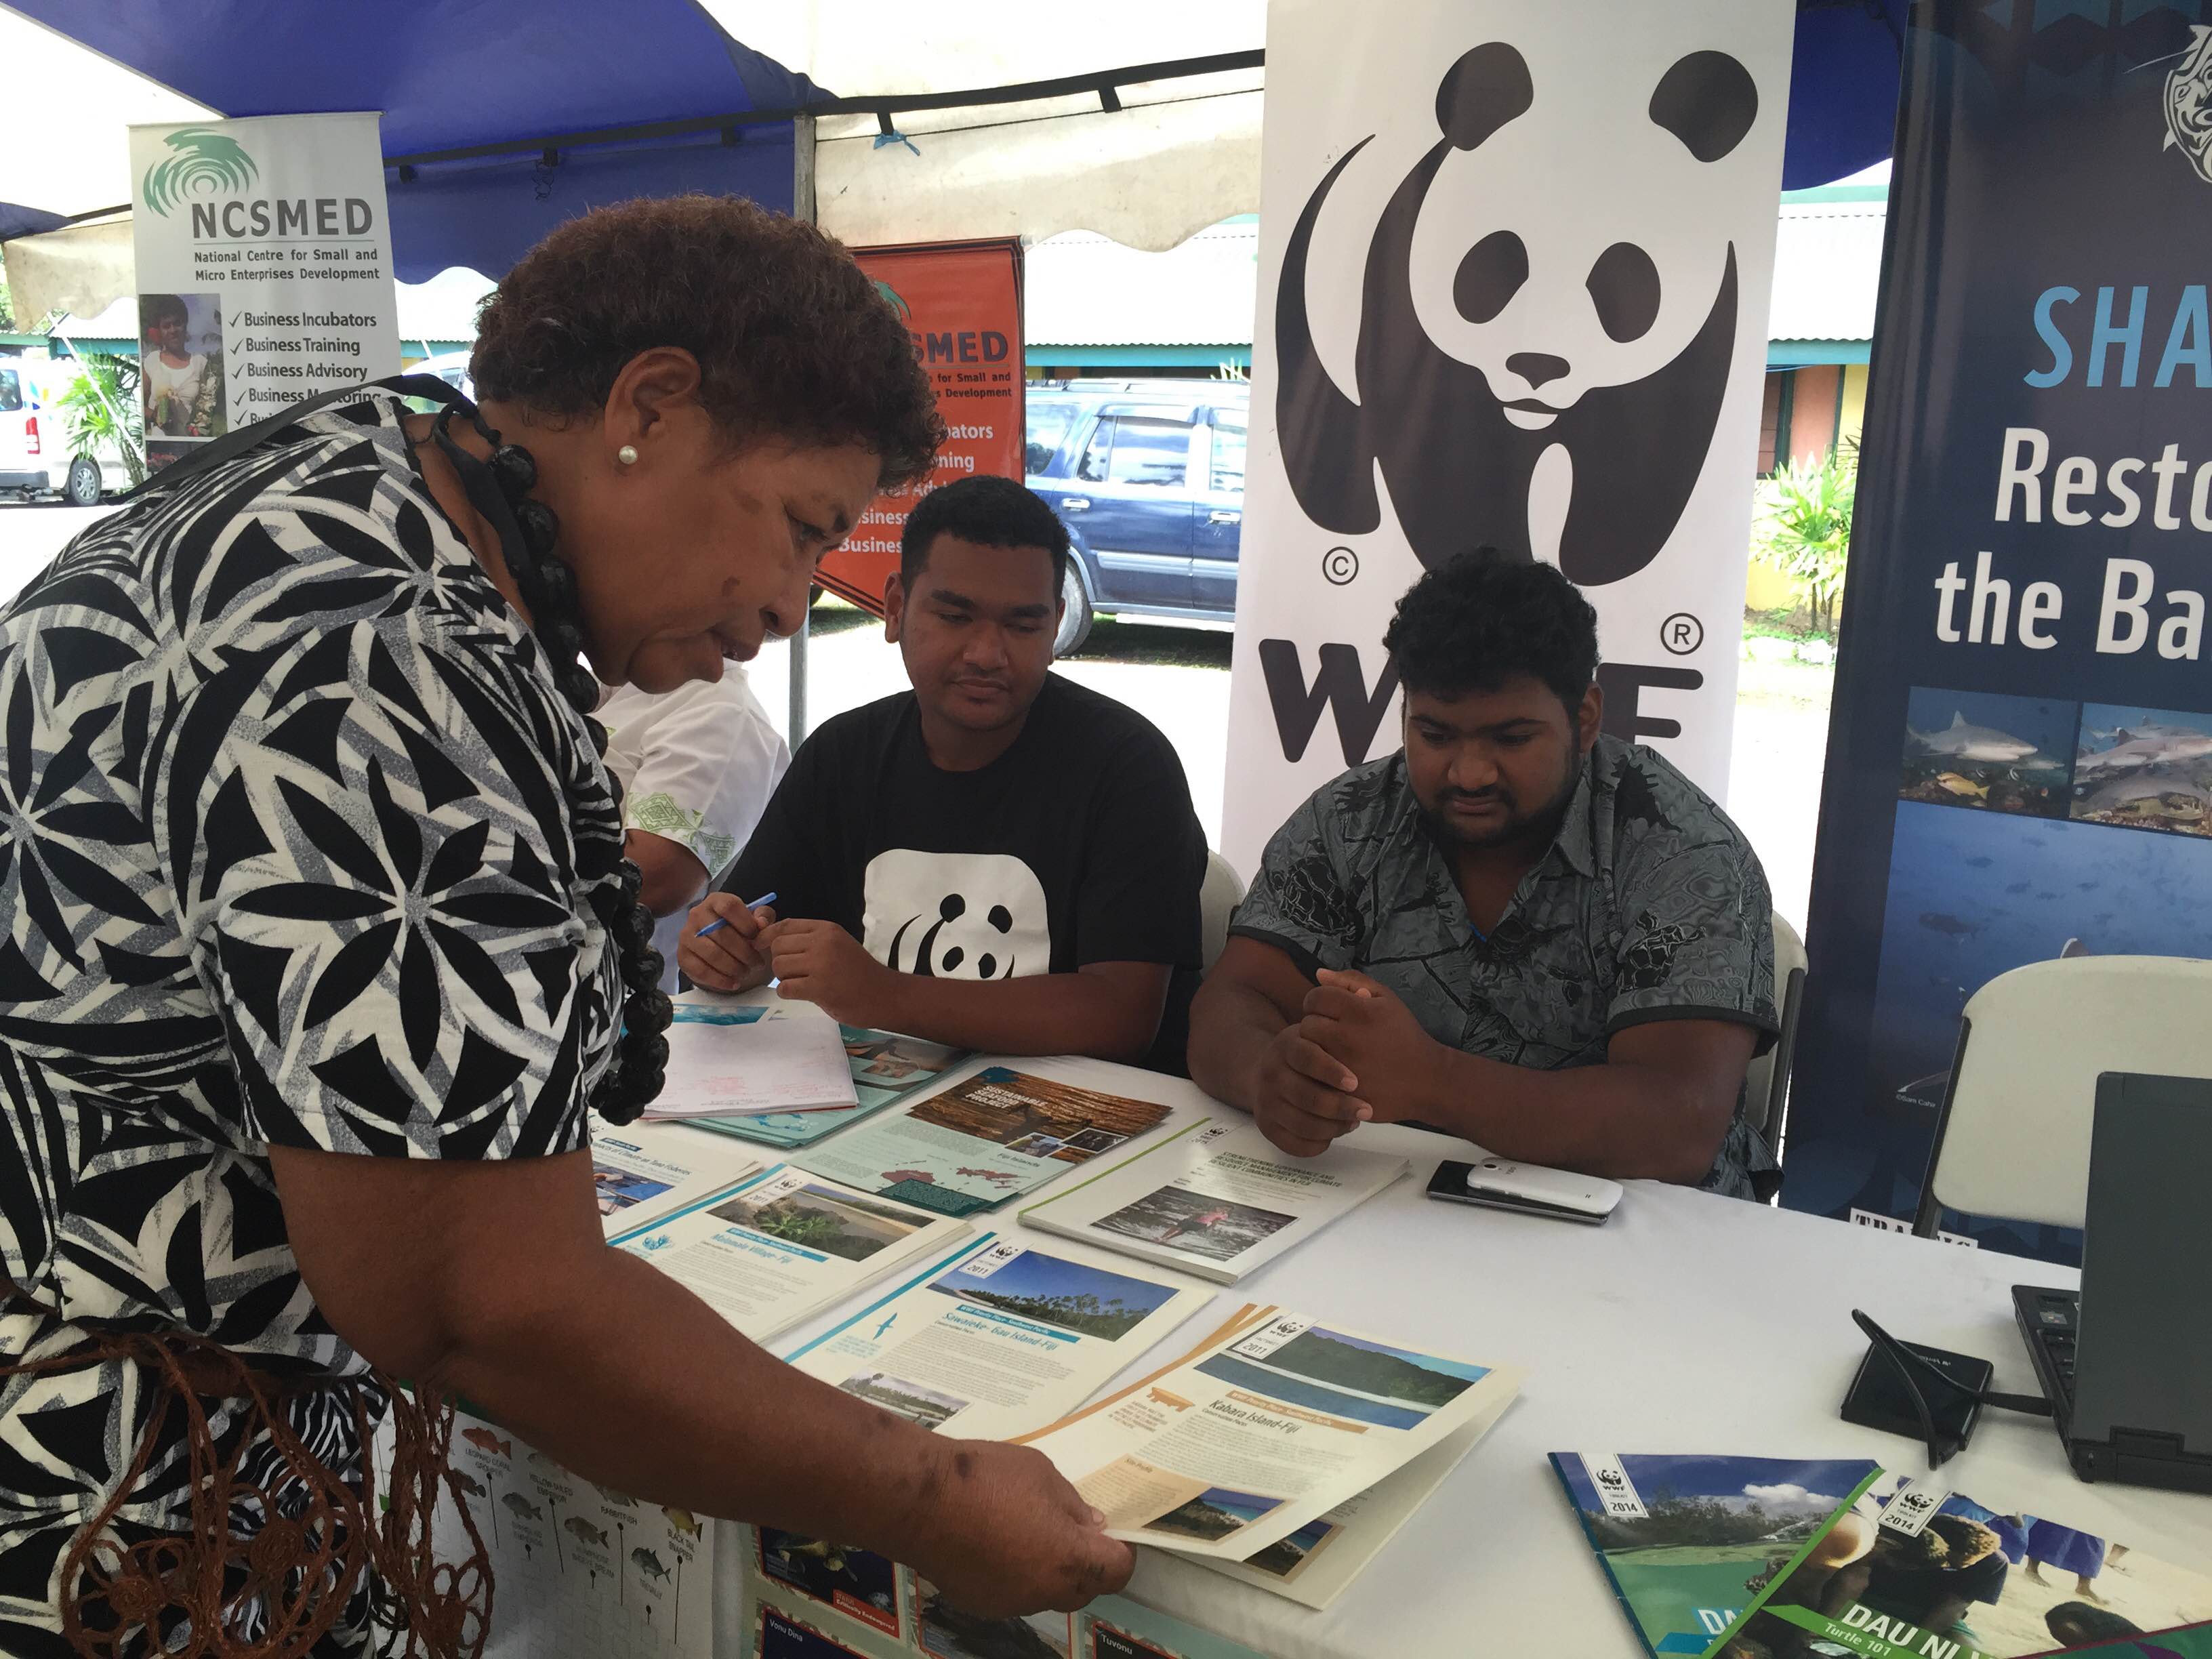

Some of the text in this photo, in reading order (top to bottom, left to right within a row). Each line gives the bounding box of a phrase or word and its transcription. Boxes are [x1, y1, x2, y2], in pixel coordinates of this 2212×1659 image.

[191, 199, 372, 239] NCSMED
[194, 248, 377, 263] National Centre for Small and
[195, 267, 380, 282] Micro Enterprises Development
[244, 311, 377, 327] Business Incubators
[246, 337, 361, 356] Business Training
[247, 362, 368, 382] Business Advisory
[938, 372, 1011, 383] for Small and
[249, 387, 304, 403] Business
[945, 388, 1012, 399] Development
[1934, 551, 2063, 650] the
[965, 1093, 1010, 1109] PROJECT
[975, 1089, 1019, 1105] SEAFOOD
[983, 1086, 1048, 1107] SUSTAINABLE
[967, 1265, 988, 1274] 2011
[1242, 1343, 1267, 1355] 2011
[1209, 1399, 1302, 1434] Kabara Island-Fiji
[1610, 1502, 1638, 1512] 2014
[1900, 1502, 1925, 1514] WWF
[1885, 1513, 1914, 1530] 2014
[770, 1618, 803, 1642] Vonu Dina
[1842, 1603, 1918, 1647] DAU
[1101, 1633, 1133, 1655] Tuvonu
[1825, 1622, 1891, 1656] Turtle 101
